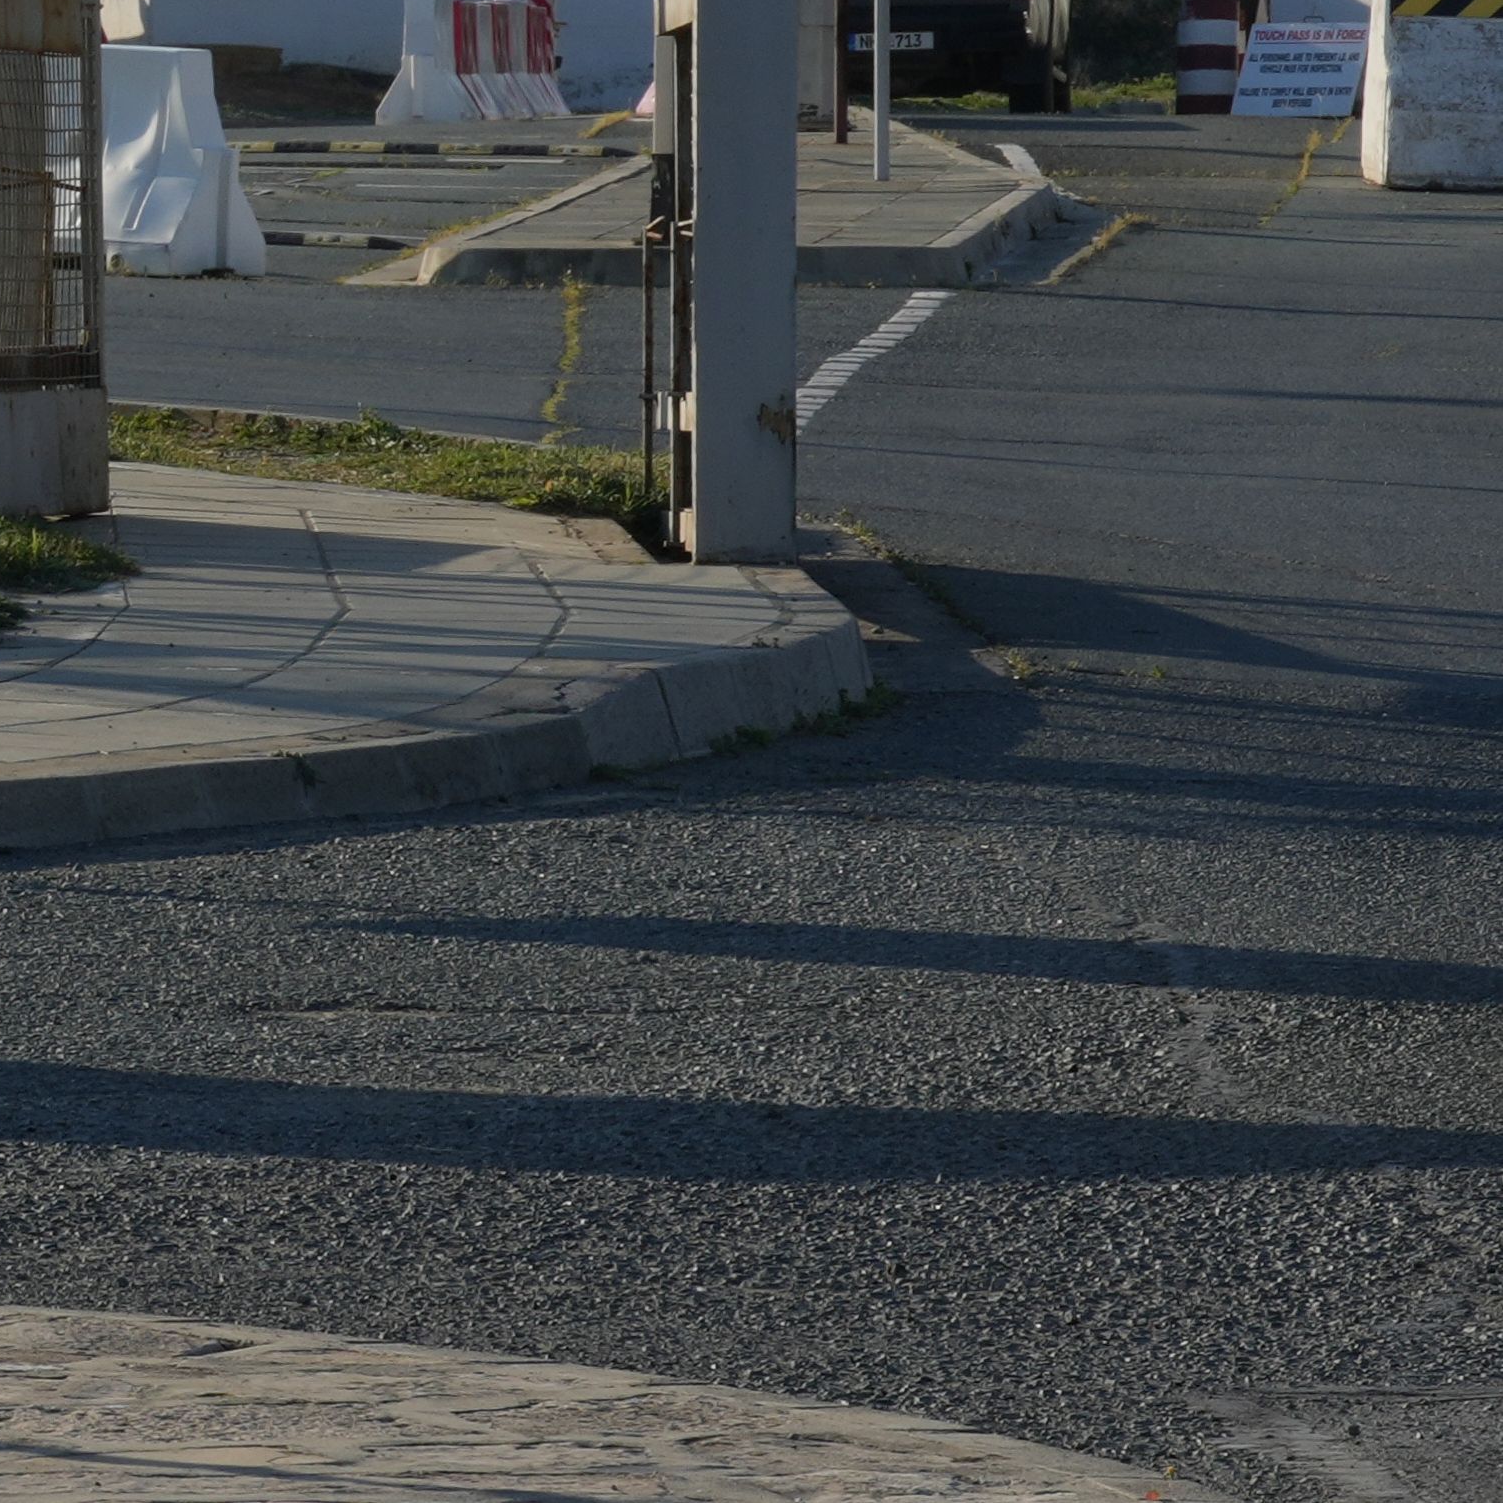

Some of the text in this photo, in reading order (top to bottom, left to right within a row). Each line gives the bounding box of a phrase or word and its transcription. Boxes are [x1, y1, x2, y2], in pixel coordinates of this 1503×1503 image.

[1287, 30, 1310, 41] PASS
[1312, 30, 1322, 41] IS
[1323, 30, 1335, 40] IN
[1336, 29, 1367, 40] FORCE
